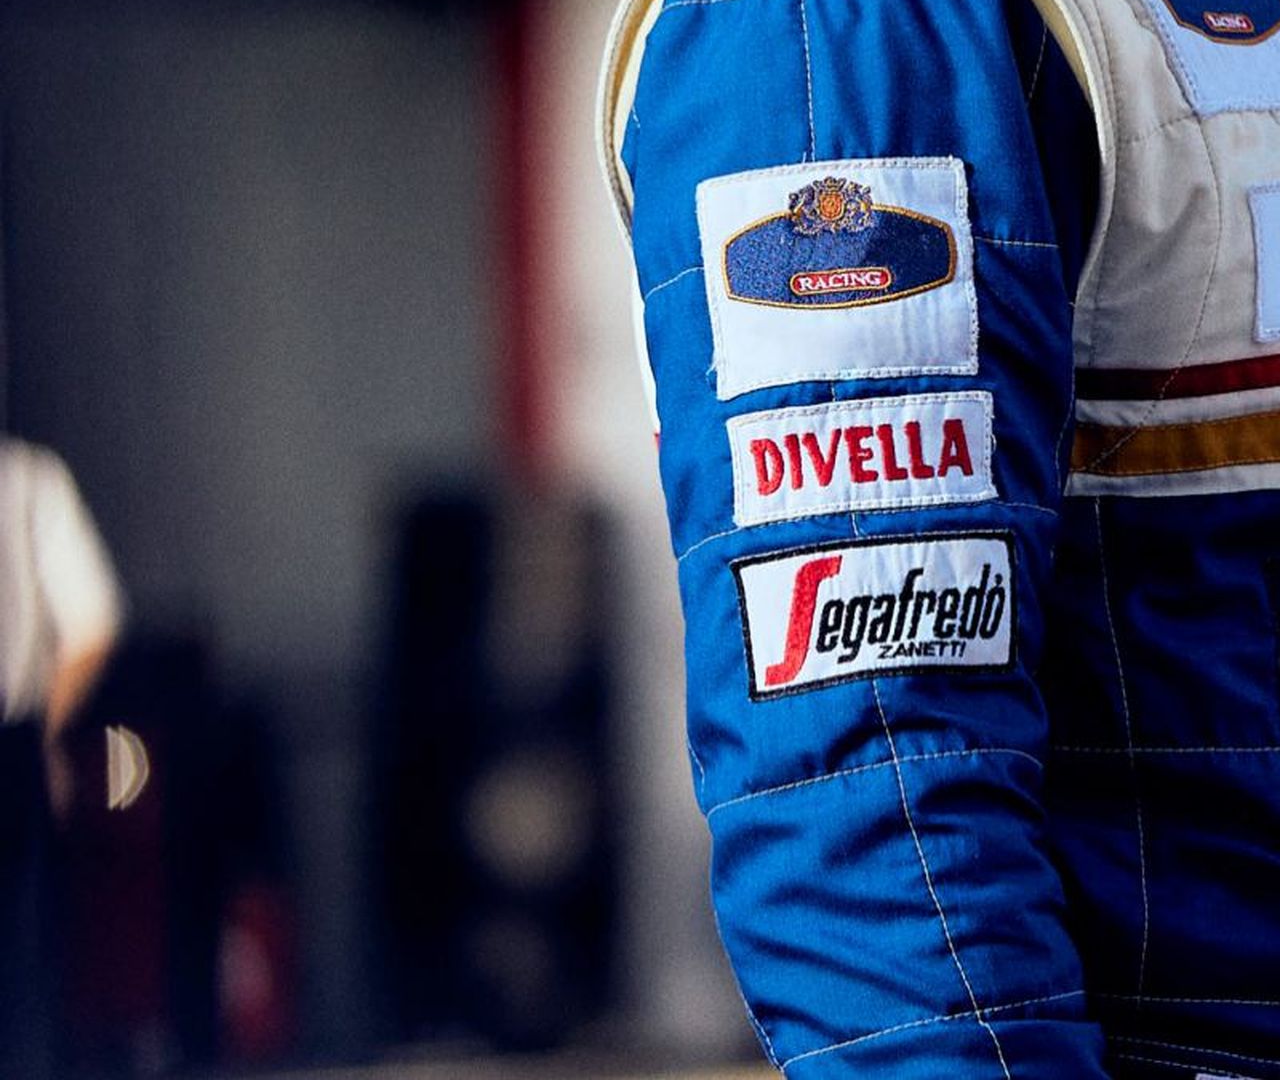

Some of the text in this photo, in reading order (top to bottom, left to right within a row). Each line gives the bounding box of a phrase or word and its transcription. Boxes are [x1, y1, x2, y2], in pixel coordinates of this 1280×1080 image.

[797, 271, 882, 292] RACING
[749, 418, 974, 497] DIVELLA
[878, 640, 967, 660] ZANETTI
